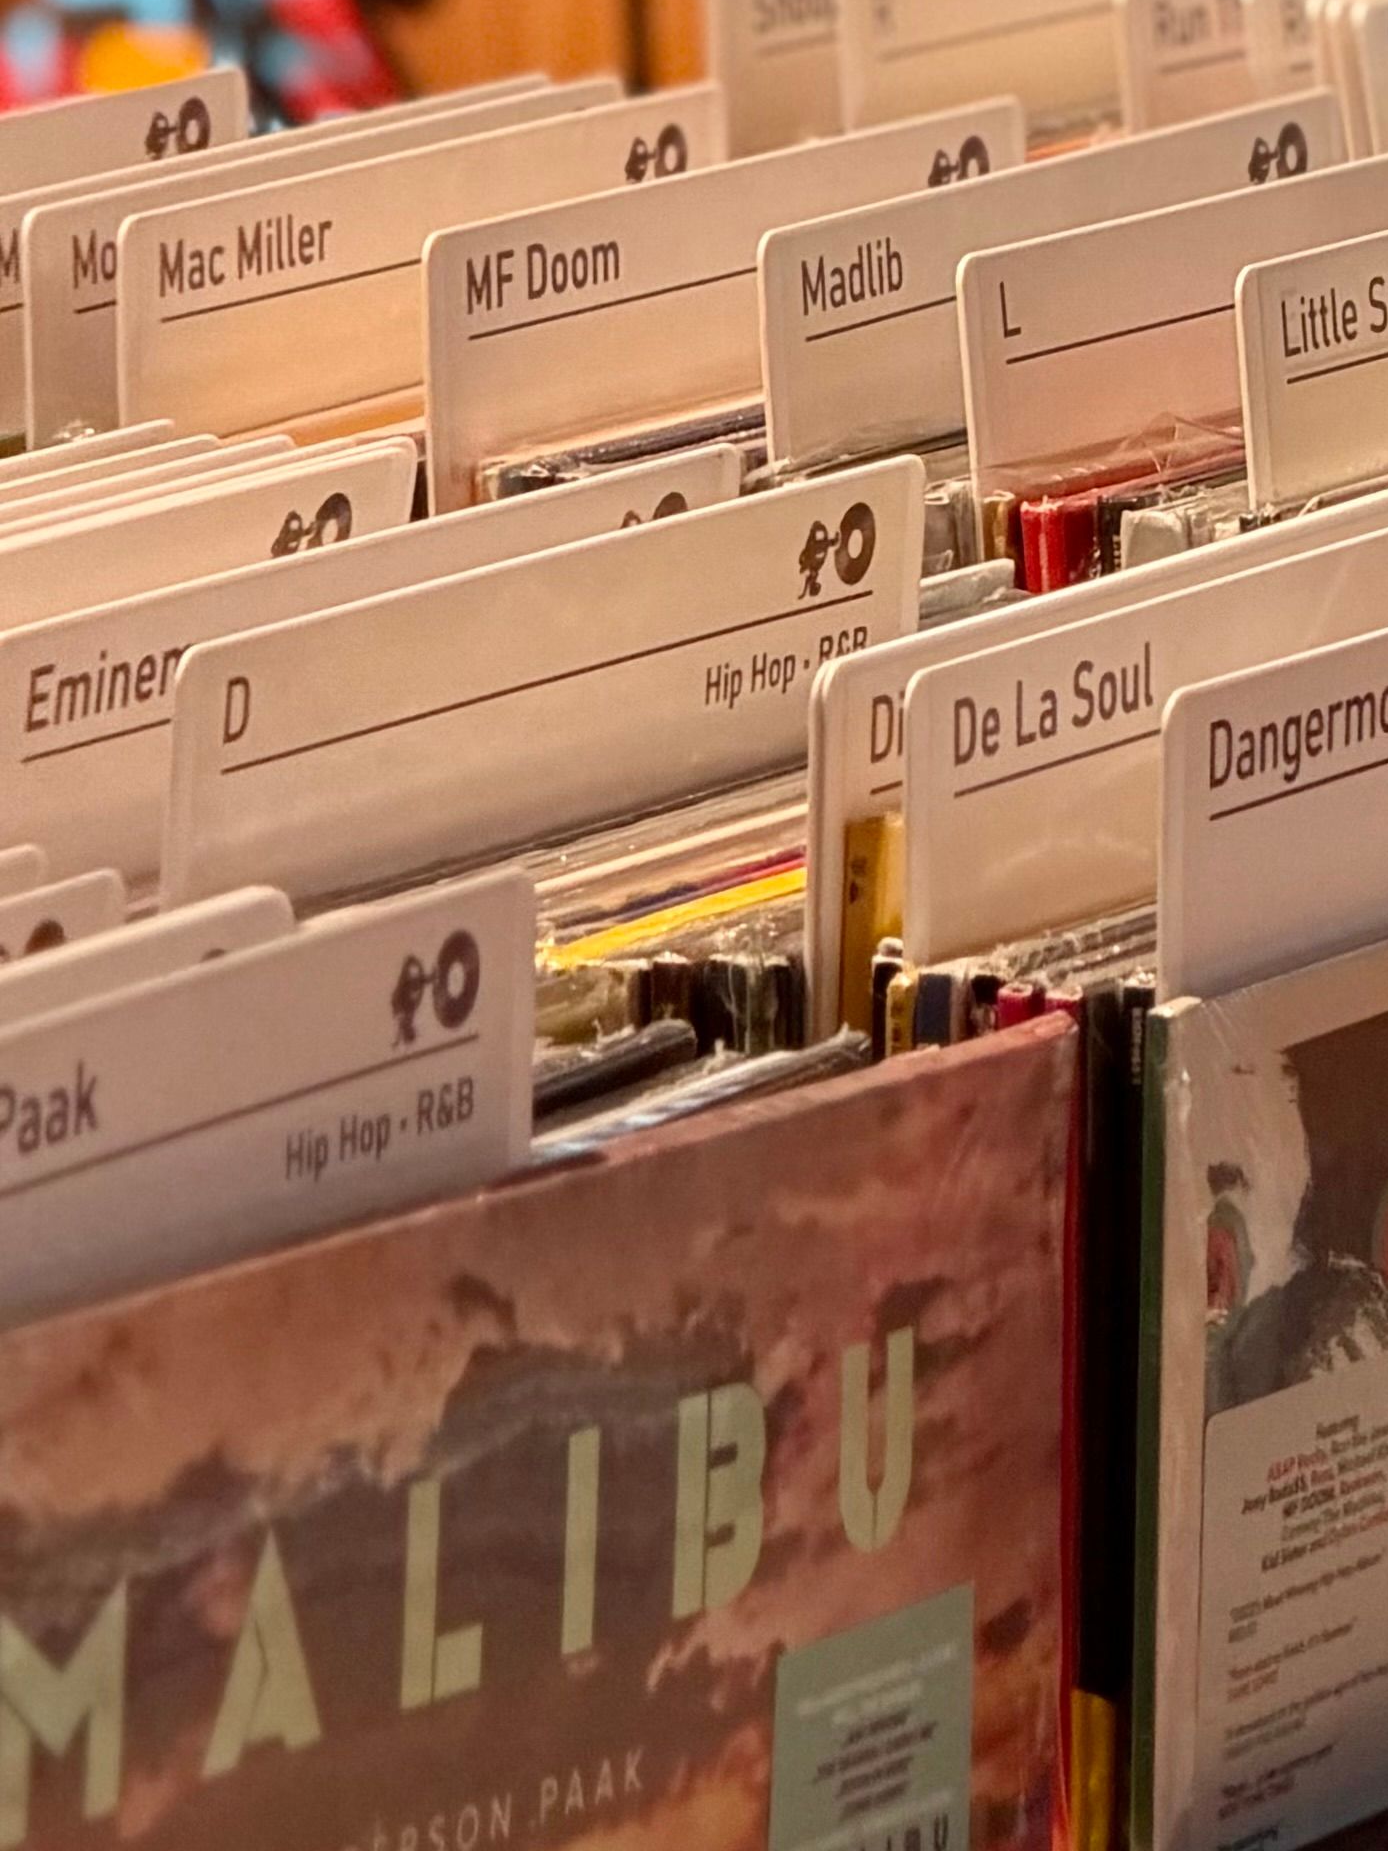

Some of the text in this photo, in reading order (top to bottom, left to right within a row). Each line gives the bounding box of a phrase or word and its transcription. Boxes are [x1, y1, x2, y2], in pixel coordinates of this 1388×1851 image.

[72, 229, 116, 289] Mo
[159, 213, 333, 297] Mac Miller
[466, 240, 620, 315] MF Doom
[801, 237, 904, 316] Madlib
[999, 280, 1022, 339] L
[1281, 287, 1358, 358] Little
[222, 675, 251, 745] D
[704, 661, 743, 710] Hip
[750, 651, 797, 695] Hop
[953, 640, 1154, 767] De La Soul
[285, 1075, 474, 1184] Hip Hop R&B
[0, 1325, 914, 1851] MALIBU
